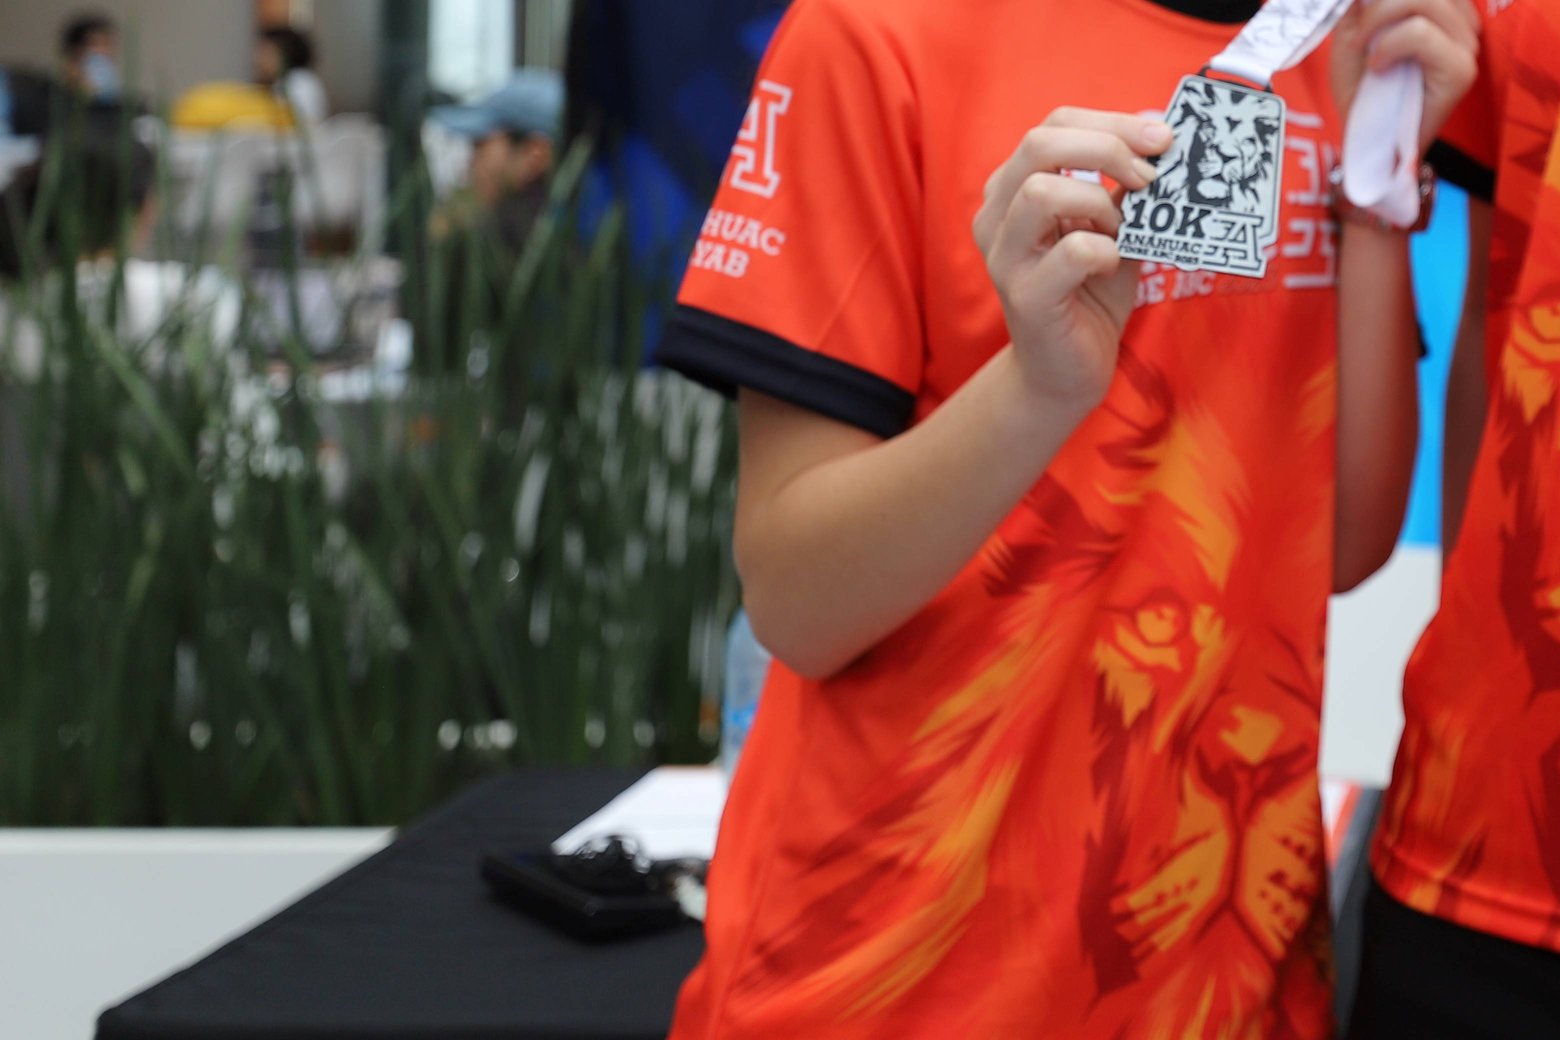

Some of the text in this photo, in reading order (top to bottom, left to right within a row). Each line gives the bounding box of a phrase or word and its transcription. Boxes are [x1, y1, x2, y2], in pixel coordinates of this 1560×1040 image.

[700, 206, 787, 258] HUAC
[1127, 199, 1212, 239] 10K
[691, 238, 751, 279] YAB
